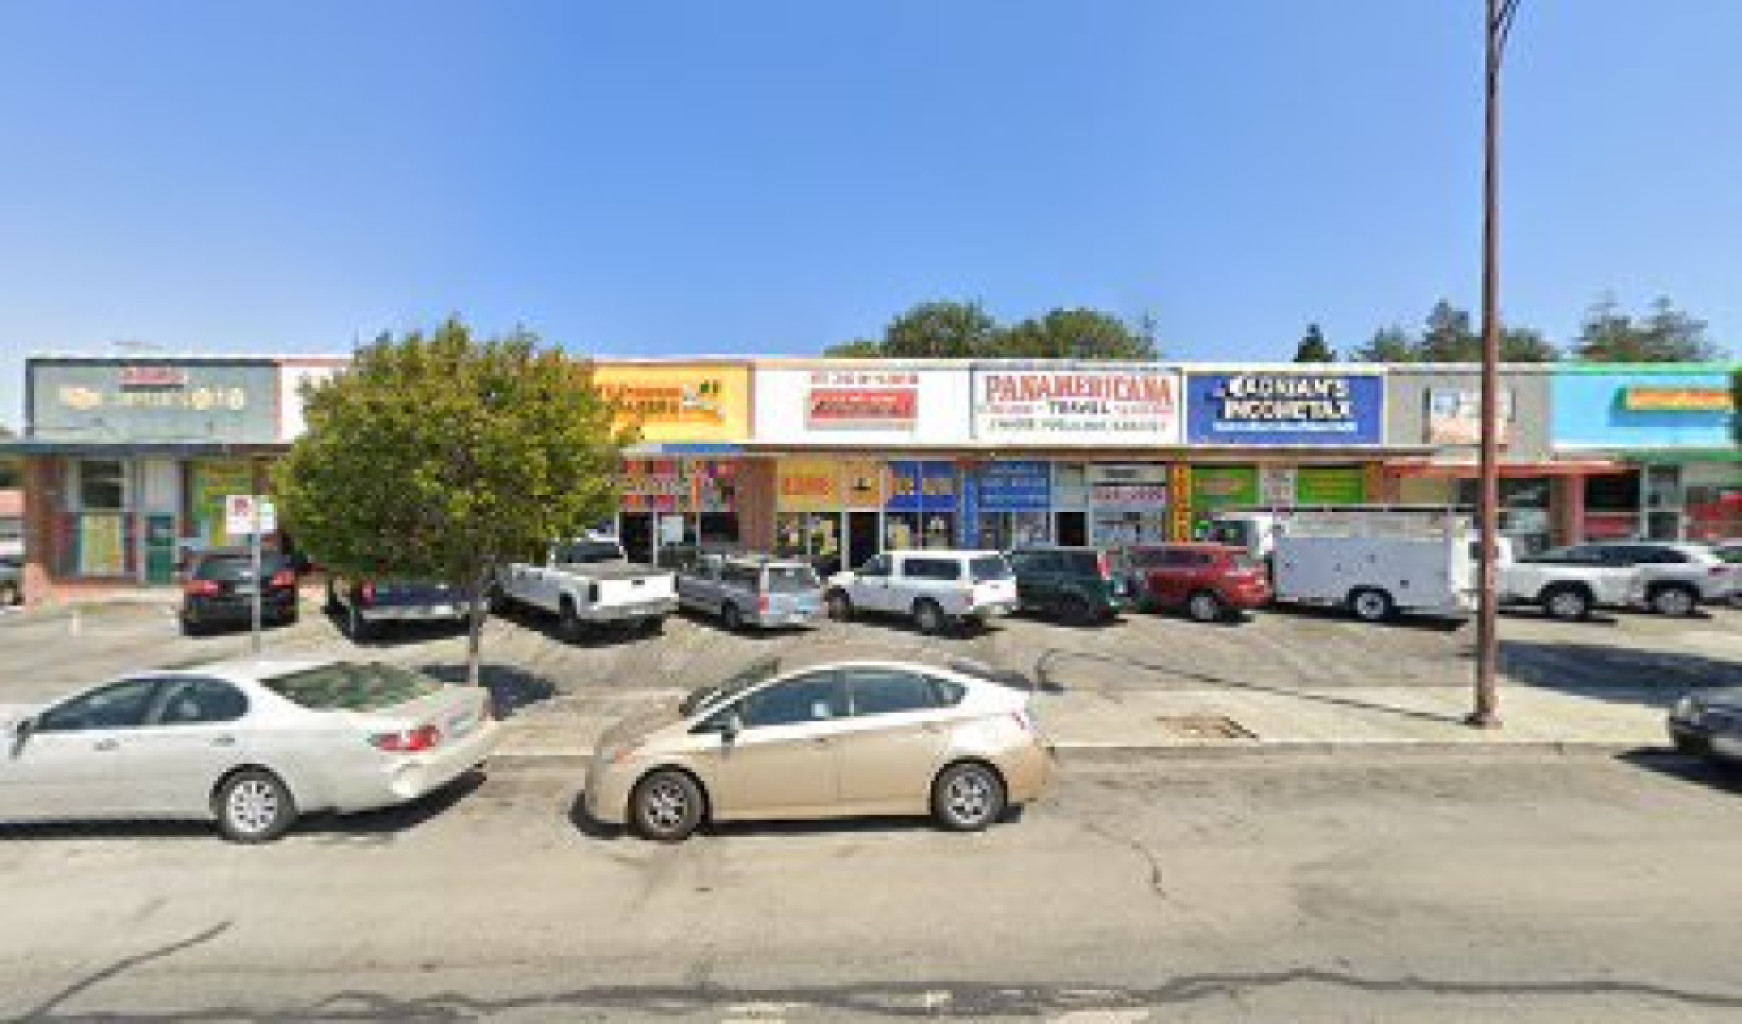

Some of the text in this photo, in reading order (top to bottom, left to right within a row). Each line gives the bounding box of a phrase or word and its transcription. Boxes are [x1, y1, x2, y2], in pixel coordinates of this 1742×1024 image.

[985, 375, 1173, 405] PANAMERICANA
[1049, 401, 1111, 414] TRAVEL
[1224, 400, 1308, 419] INCOME
